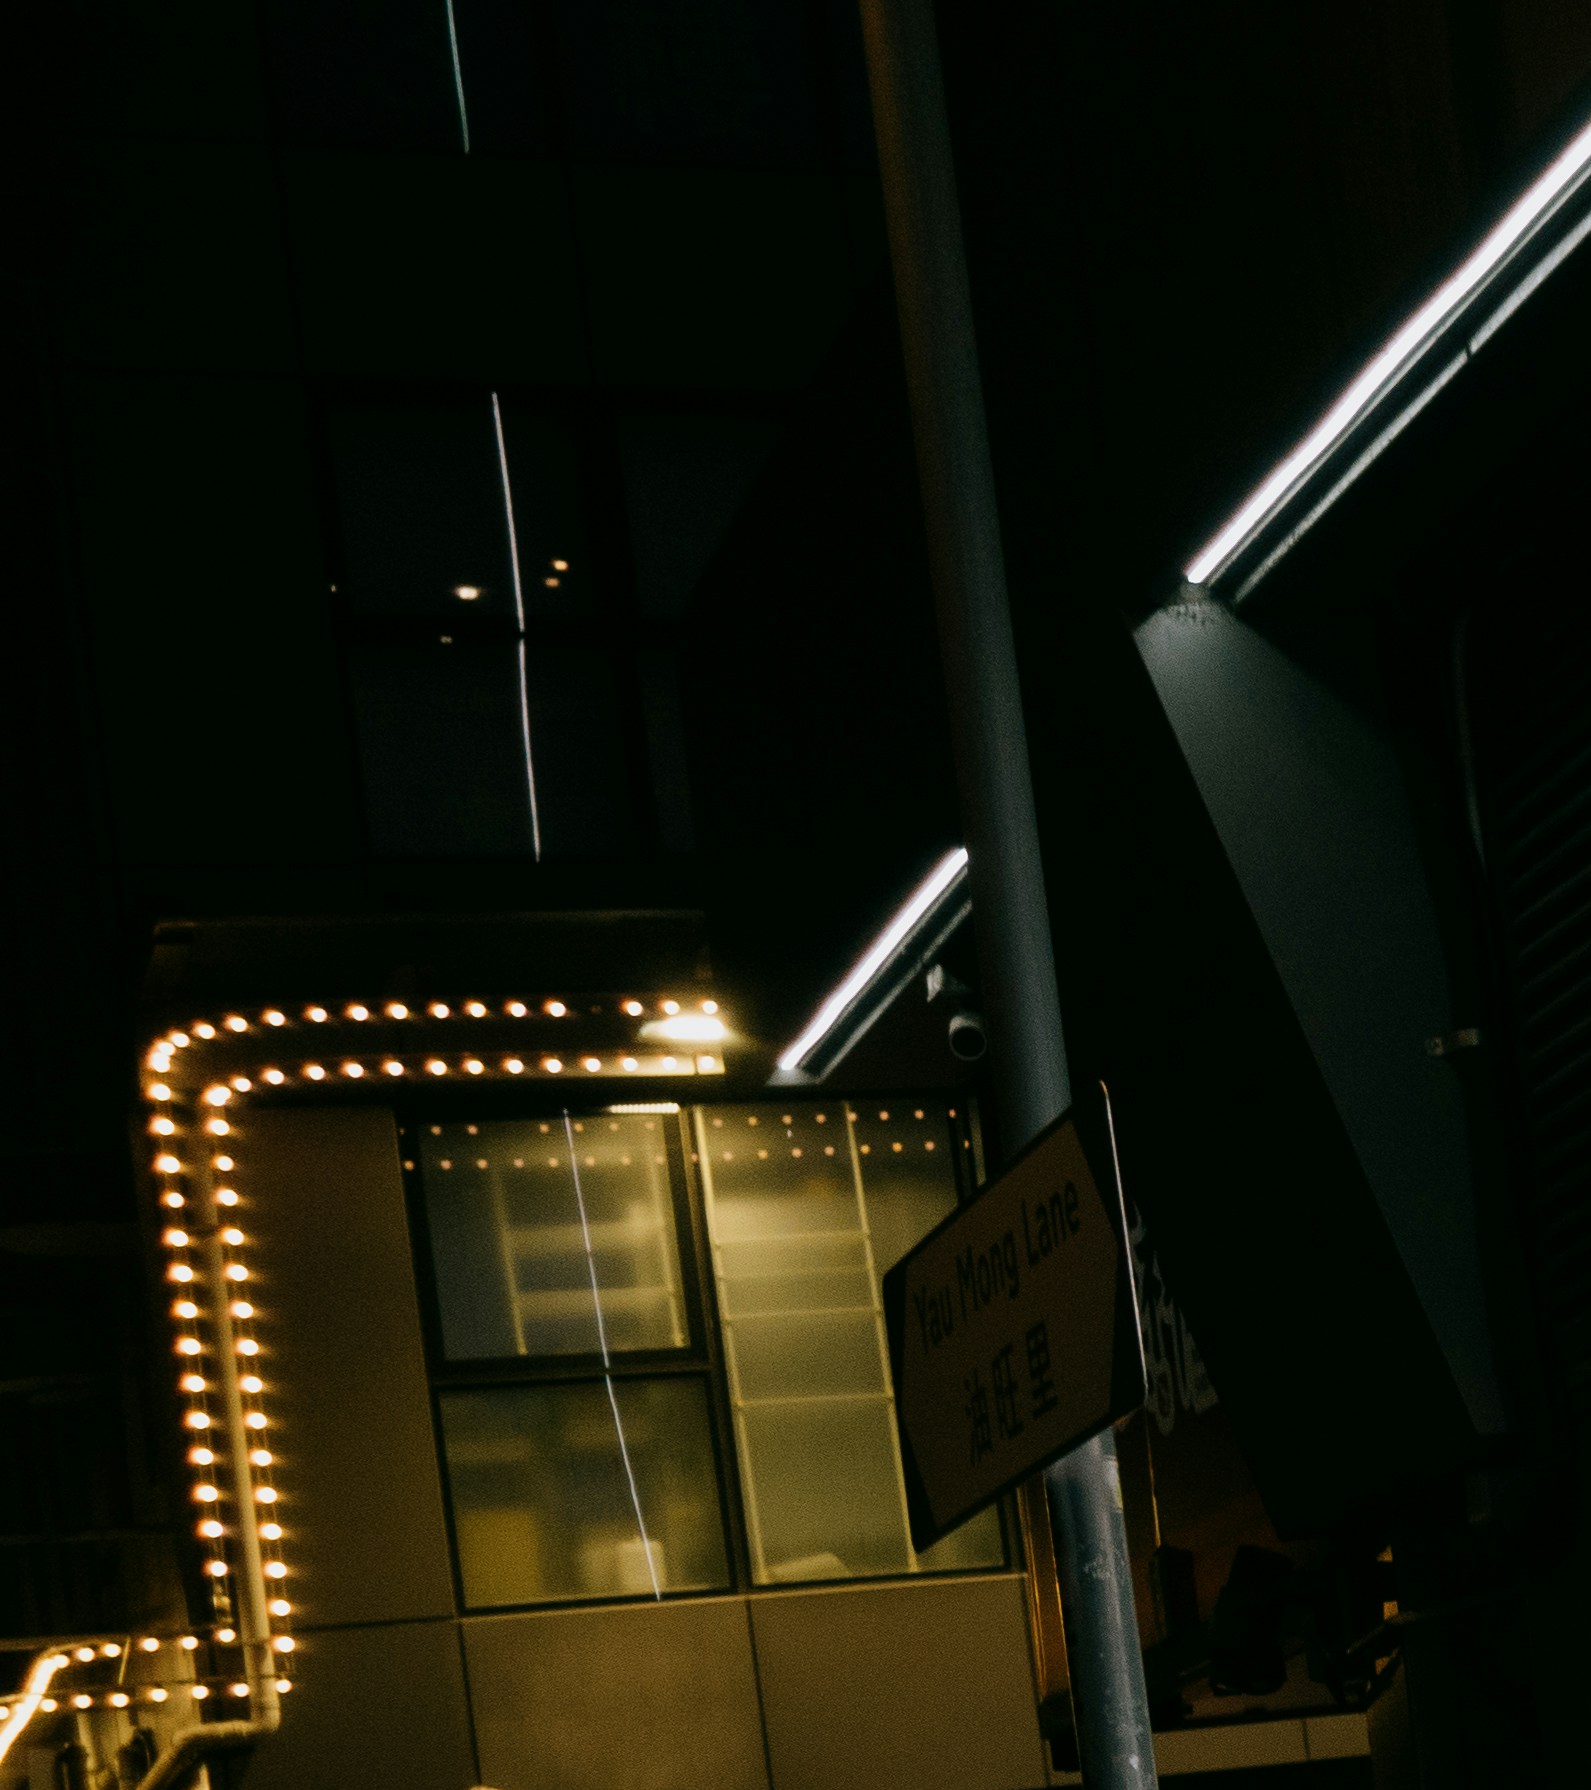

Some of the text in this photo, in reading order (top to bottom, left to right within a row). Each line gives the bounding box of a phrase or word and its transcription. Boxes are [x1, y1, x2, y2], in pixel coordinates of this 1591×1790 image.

[913, 1180, 1082, 1354] Yau Mong Lane
